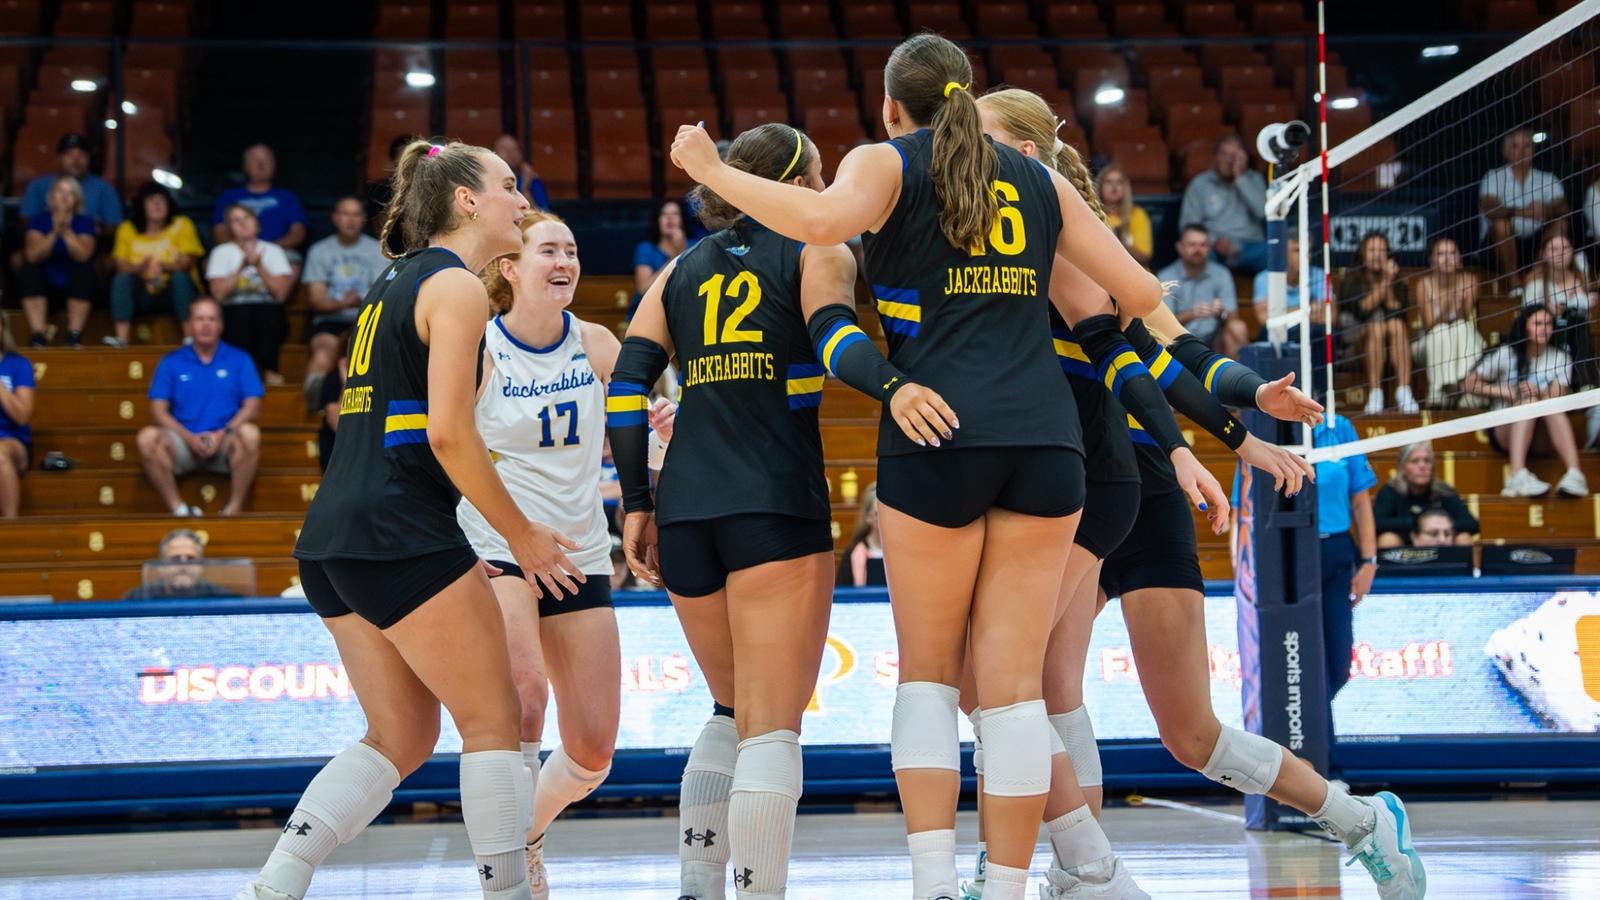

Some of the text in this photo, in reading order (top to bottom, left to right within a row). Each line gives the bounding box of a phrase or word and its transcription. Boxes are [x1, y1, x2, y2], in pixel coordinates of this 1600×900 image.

[970, 180, 1026, 256] 6
[944, 265, 1038, 297] JACKRABBITS
[697, 270, 763, 346] 12
[347, 300, 383, 378] 10
[686, 352, 774, 388] JACKRABBITS
[537, 400, 580, 448] 17
[1529, 505, 1544, 528] E
[141, 662, 352, 704] DISCOUN
